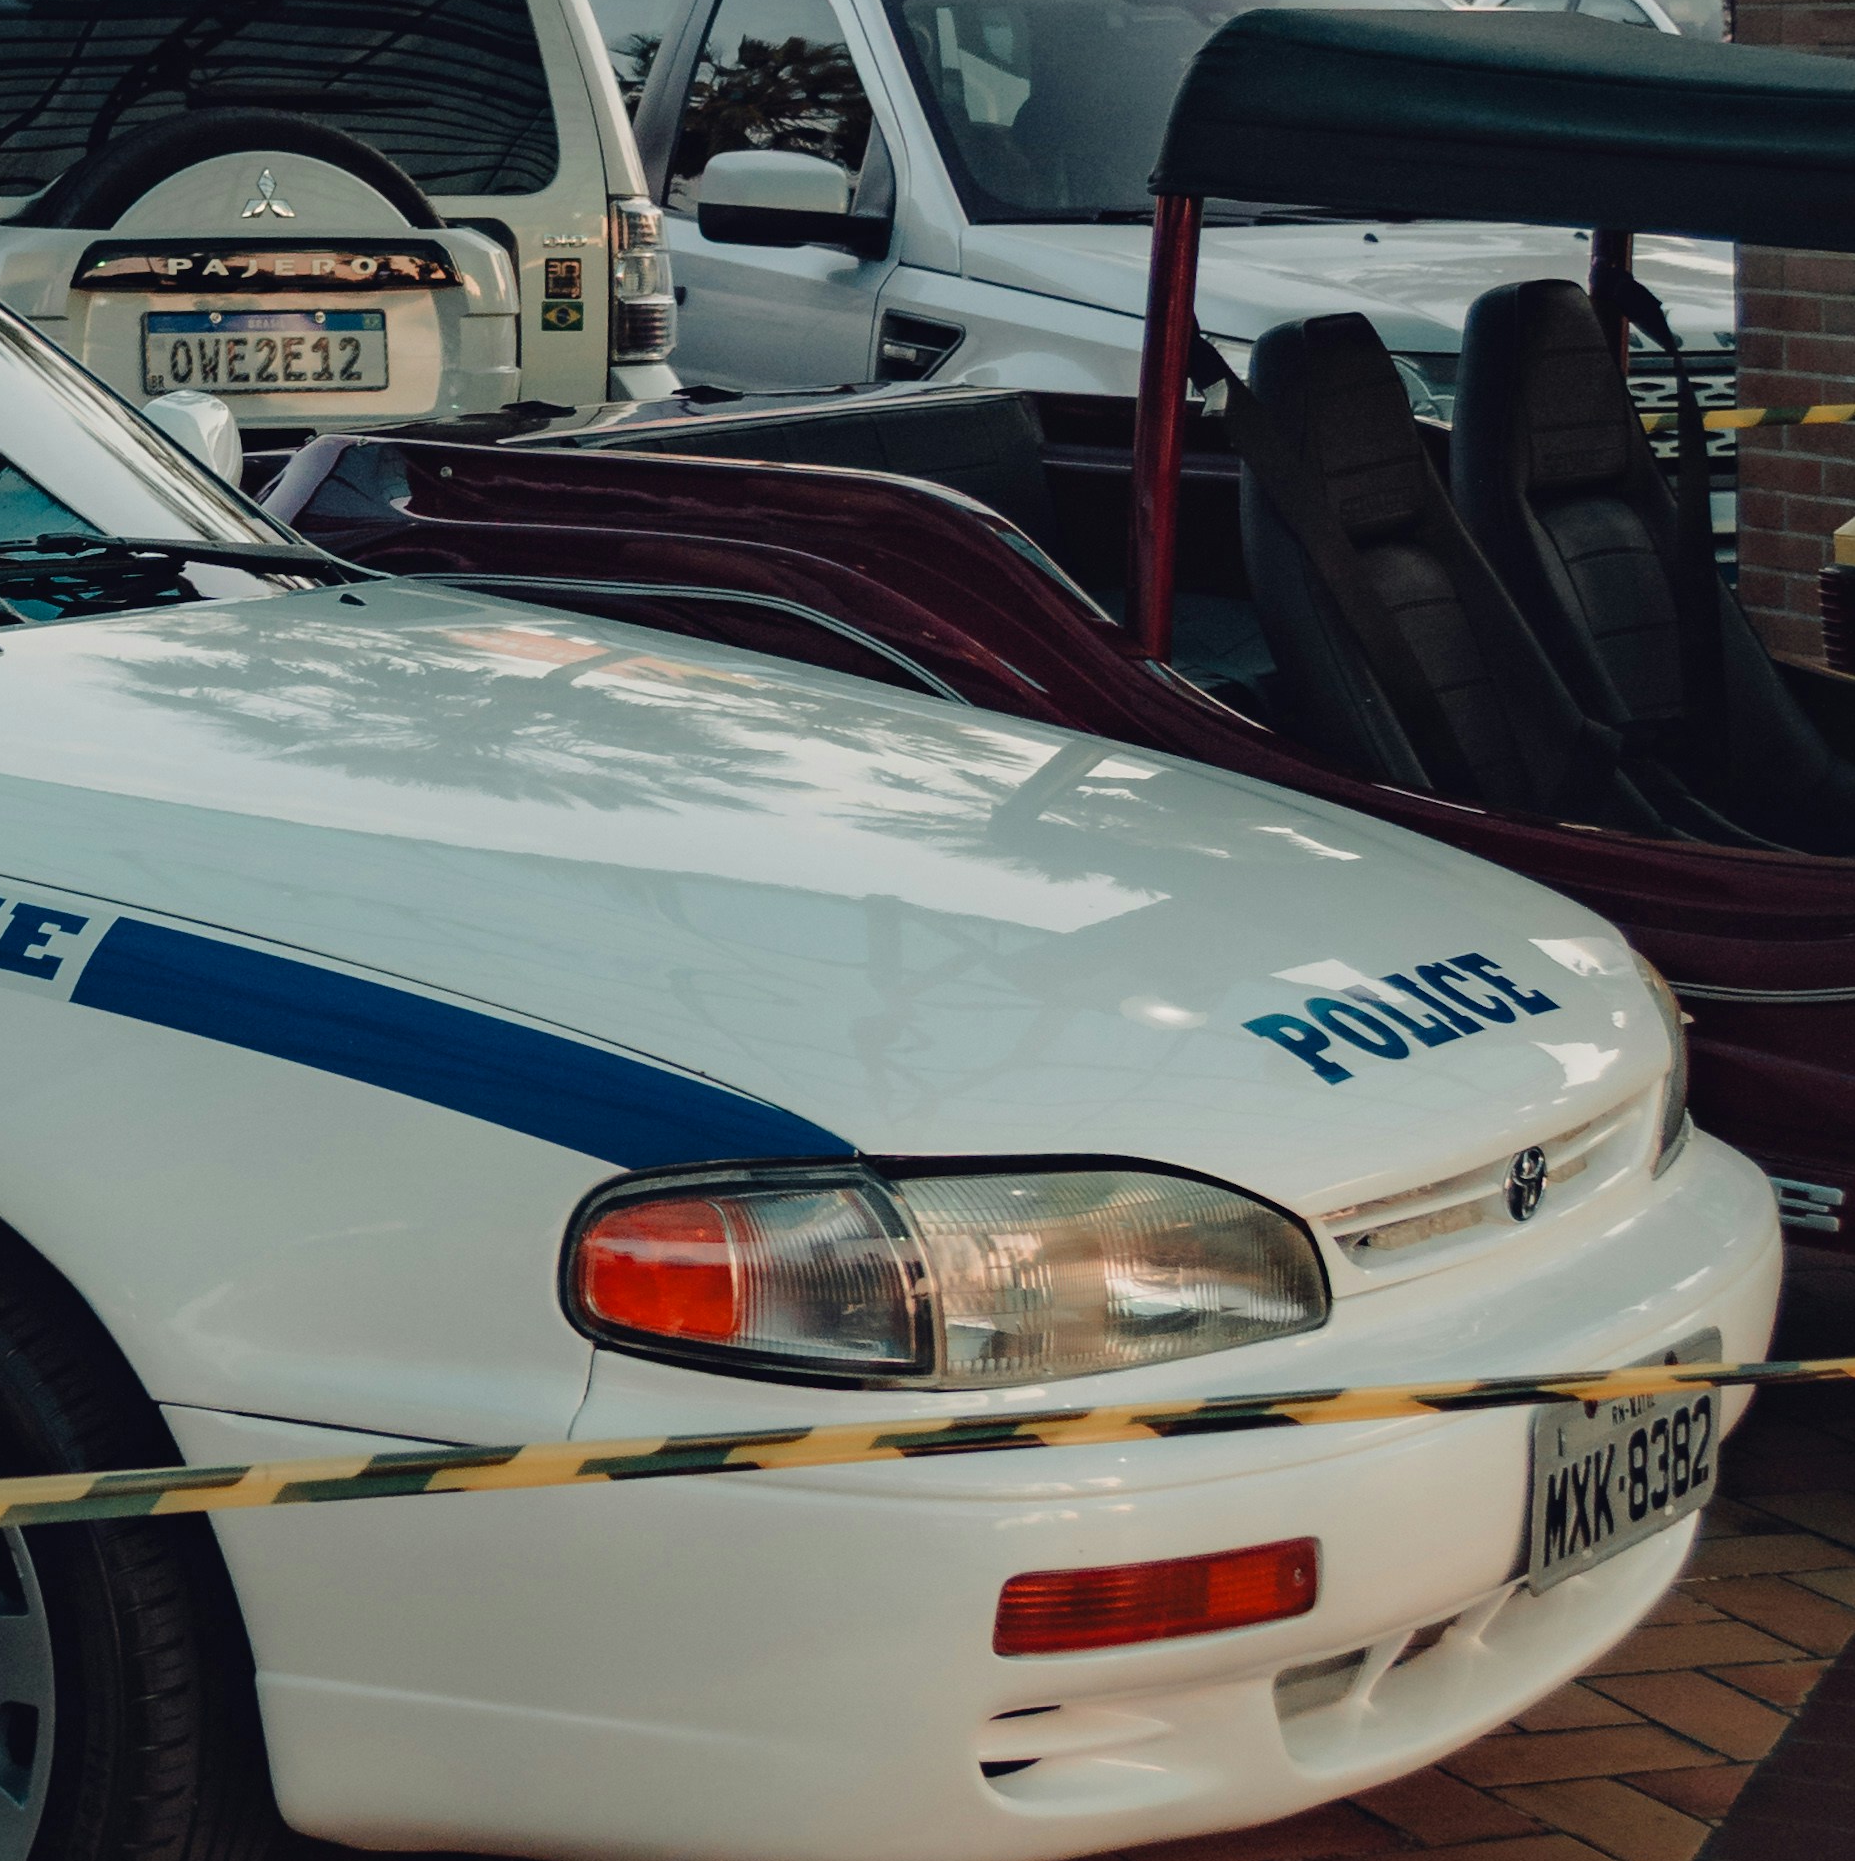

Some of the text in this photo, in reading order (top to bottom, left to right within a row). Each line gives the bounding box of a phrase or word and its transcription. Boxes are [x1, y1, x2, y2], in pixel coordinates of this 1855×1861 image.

[167, 257, 379, 279] PAJERO
[247, 319, 288, 329] BRASIL
[169, 337, 363, 384] OWE2E12
[149, 375, 165, 389] BR
[1241, 952, 1561, 1085] POLICE
